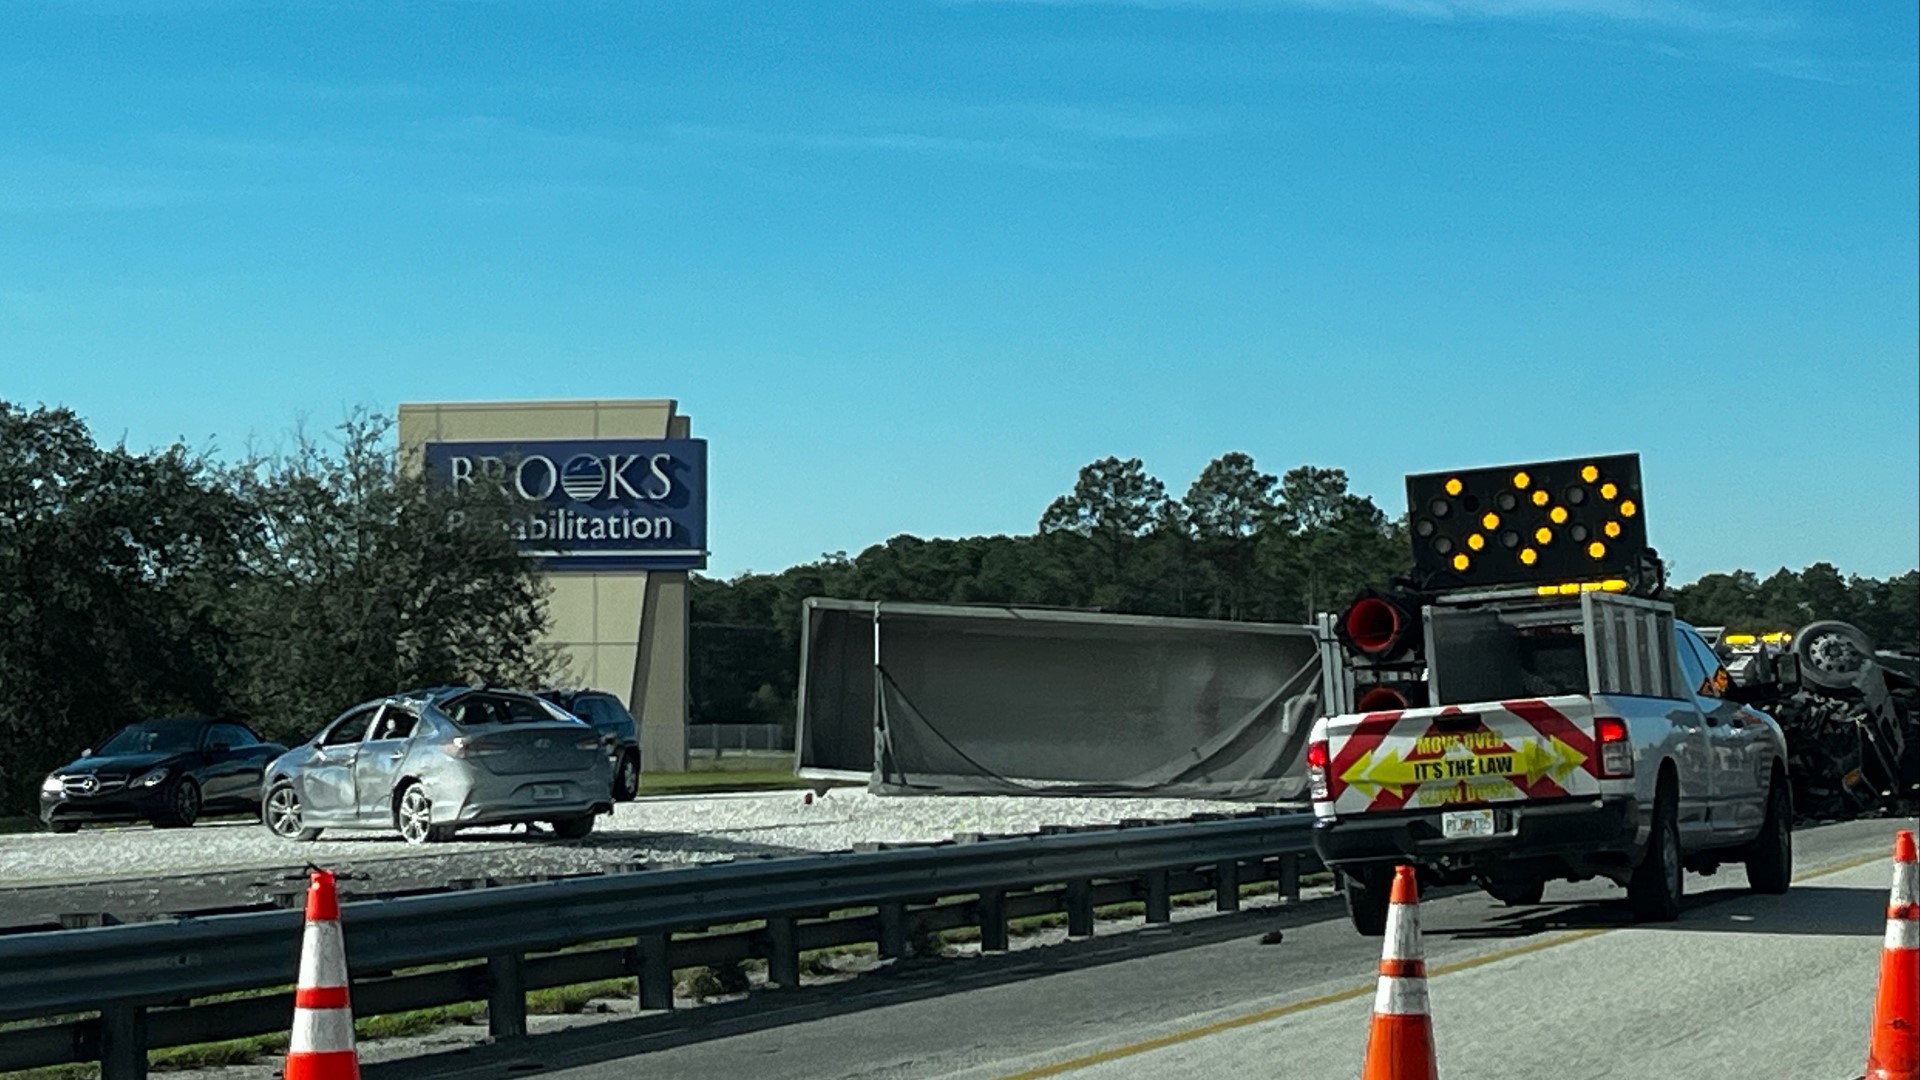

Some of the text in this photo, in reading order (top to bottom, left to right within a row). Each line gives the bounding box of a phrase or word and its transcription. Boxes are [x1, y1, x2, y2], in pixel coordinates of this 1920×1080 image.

[1415, 756, 1513, 780] IT'S THE LAW
